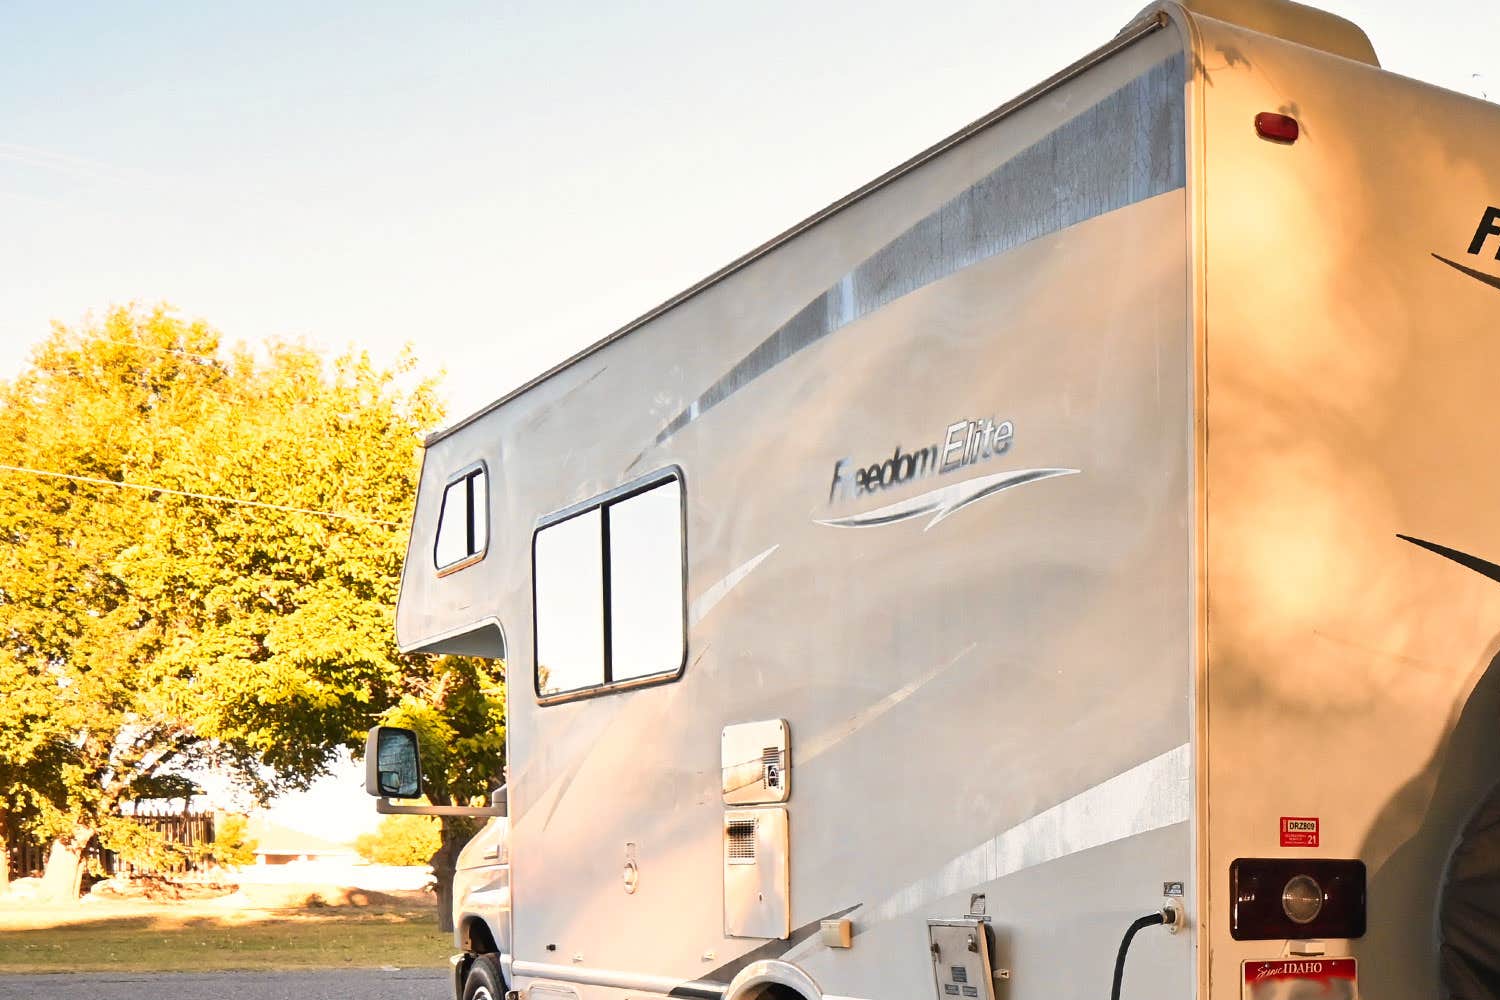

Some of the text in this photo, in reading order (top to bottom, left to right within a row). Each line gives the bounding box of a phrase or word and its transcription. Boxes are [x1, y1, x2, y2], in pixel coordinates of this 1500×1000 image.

[829, 417, 1014, 504] Feedom Elite
[1283, 962, 1323, 974] IDAHO
